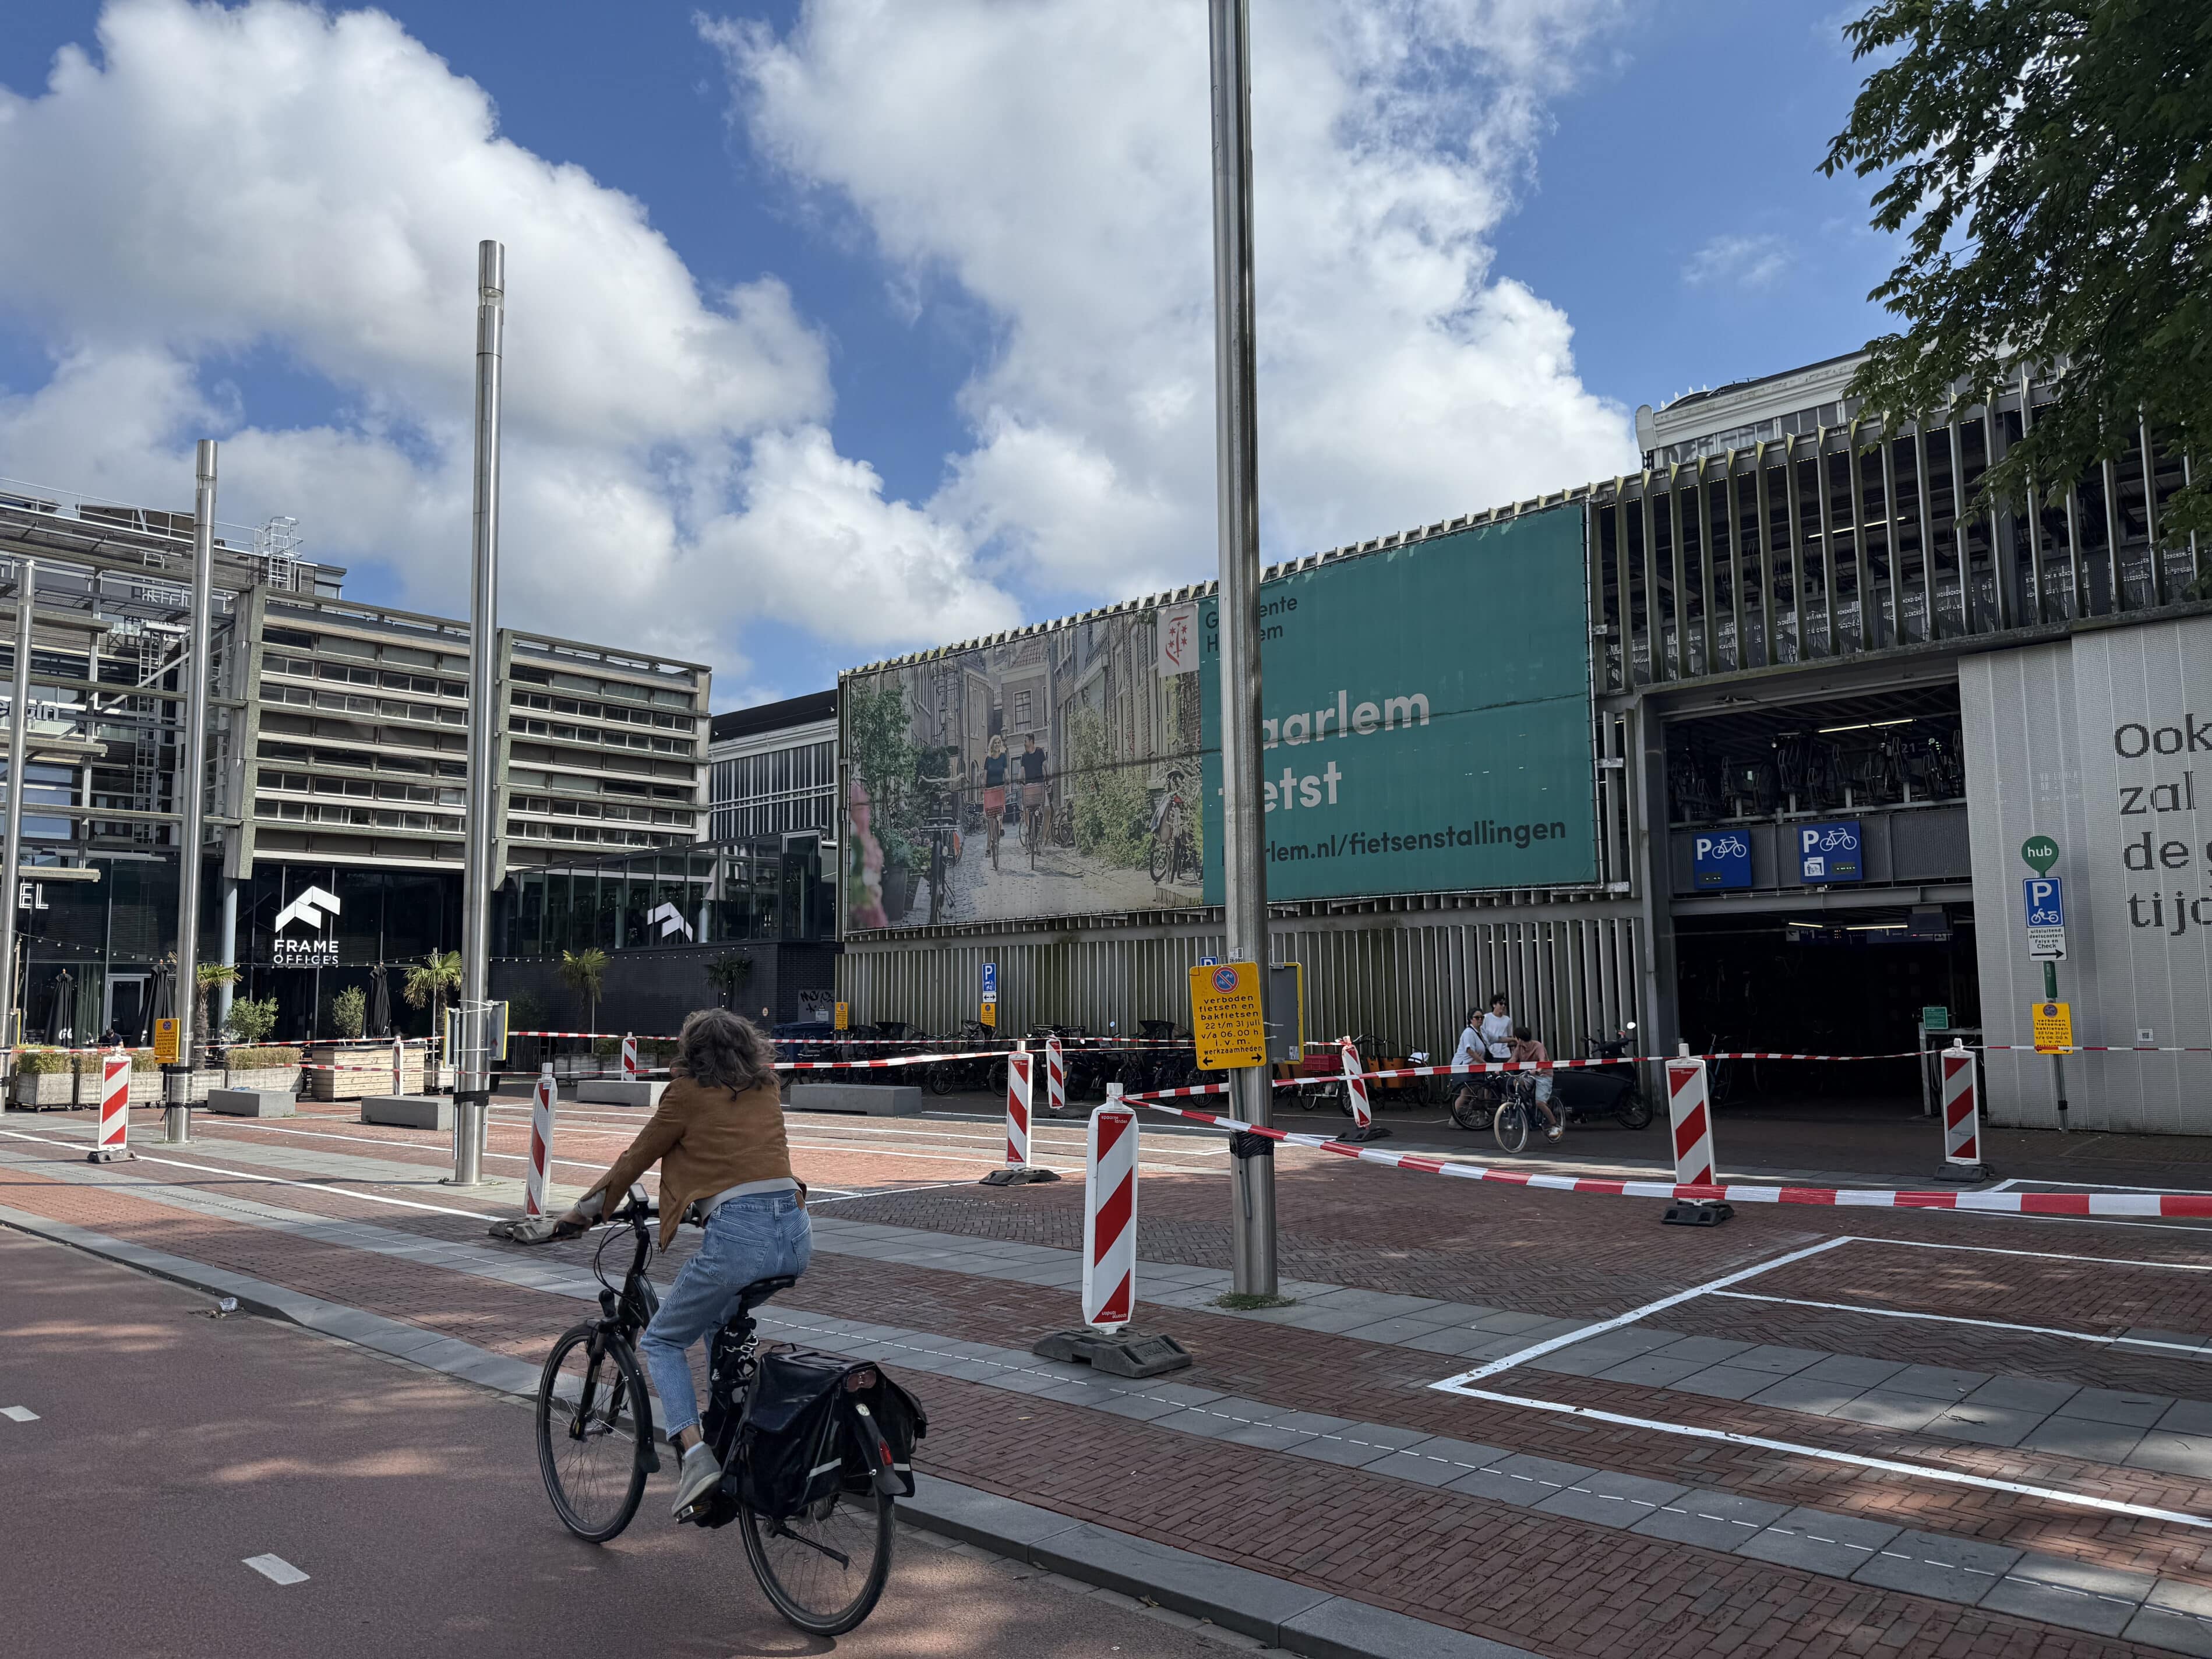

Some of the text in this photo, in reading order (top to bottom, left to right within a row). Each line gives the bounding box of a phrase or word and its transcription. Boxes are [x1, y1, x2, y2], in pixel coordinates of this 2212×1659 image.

[1205, 596, 1297, 629] Gente
[1261, 690, 1430, 751] aarlem
[2114, 713, 2212, 758] Ook
[1218, 761, 1342, 813] etst
[2119, 771, 2196, 816] zal
[1222, 820, 1566, 866] lem.nl/fietsenstallingen
[1696, 839, 1712, 860] P
[1803, 830, 1819, 853] P
[2027, 845, 2052, 857] hub
[2123, 831, 2190, 871] de
[2032, 882, 2052, 906] P
[274, 940, 338, 953] FRAME
[273, 955, 338, 964] OFFICES
[985, 965, 993, 980] P
[1199, 1004, 1237, 1012] fietsen
[1204, 995, 1253, 1004] verboden
[1201, 1011, 1258, 1020] bakfietsen
[1247, 1019, 1260, 1028] juli
[1220, 1029, 1250, 1037] 06.00
[1204, 1045, 1262, 1055] werkzaamheden
